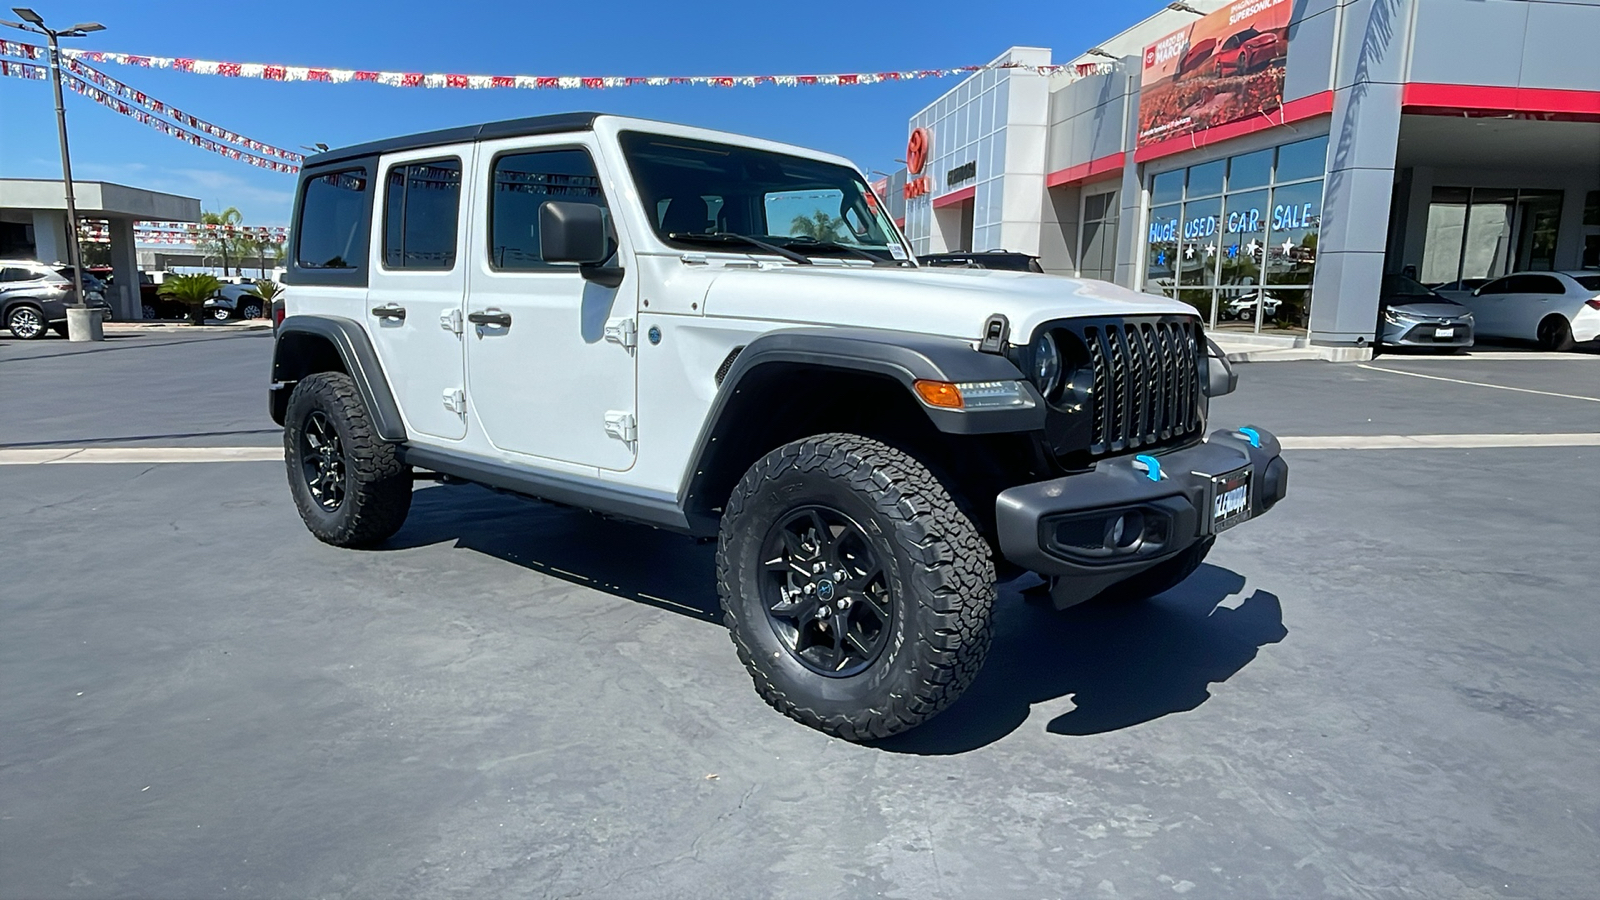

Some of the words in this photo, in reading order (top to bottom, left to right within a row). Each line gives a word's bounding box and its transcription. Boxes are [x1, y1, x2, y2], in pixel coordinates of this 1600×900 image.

[1229, 0, 1272, 25] SUPERSONIC
[1149, 219, 1177, 243] HUGE
[1185, 216, 1215, 239] USED
[1228, 208, 1260, 233] CAR
[1272, 203, 1312, 231] SALE
